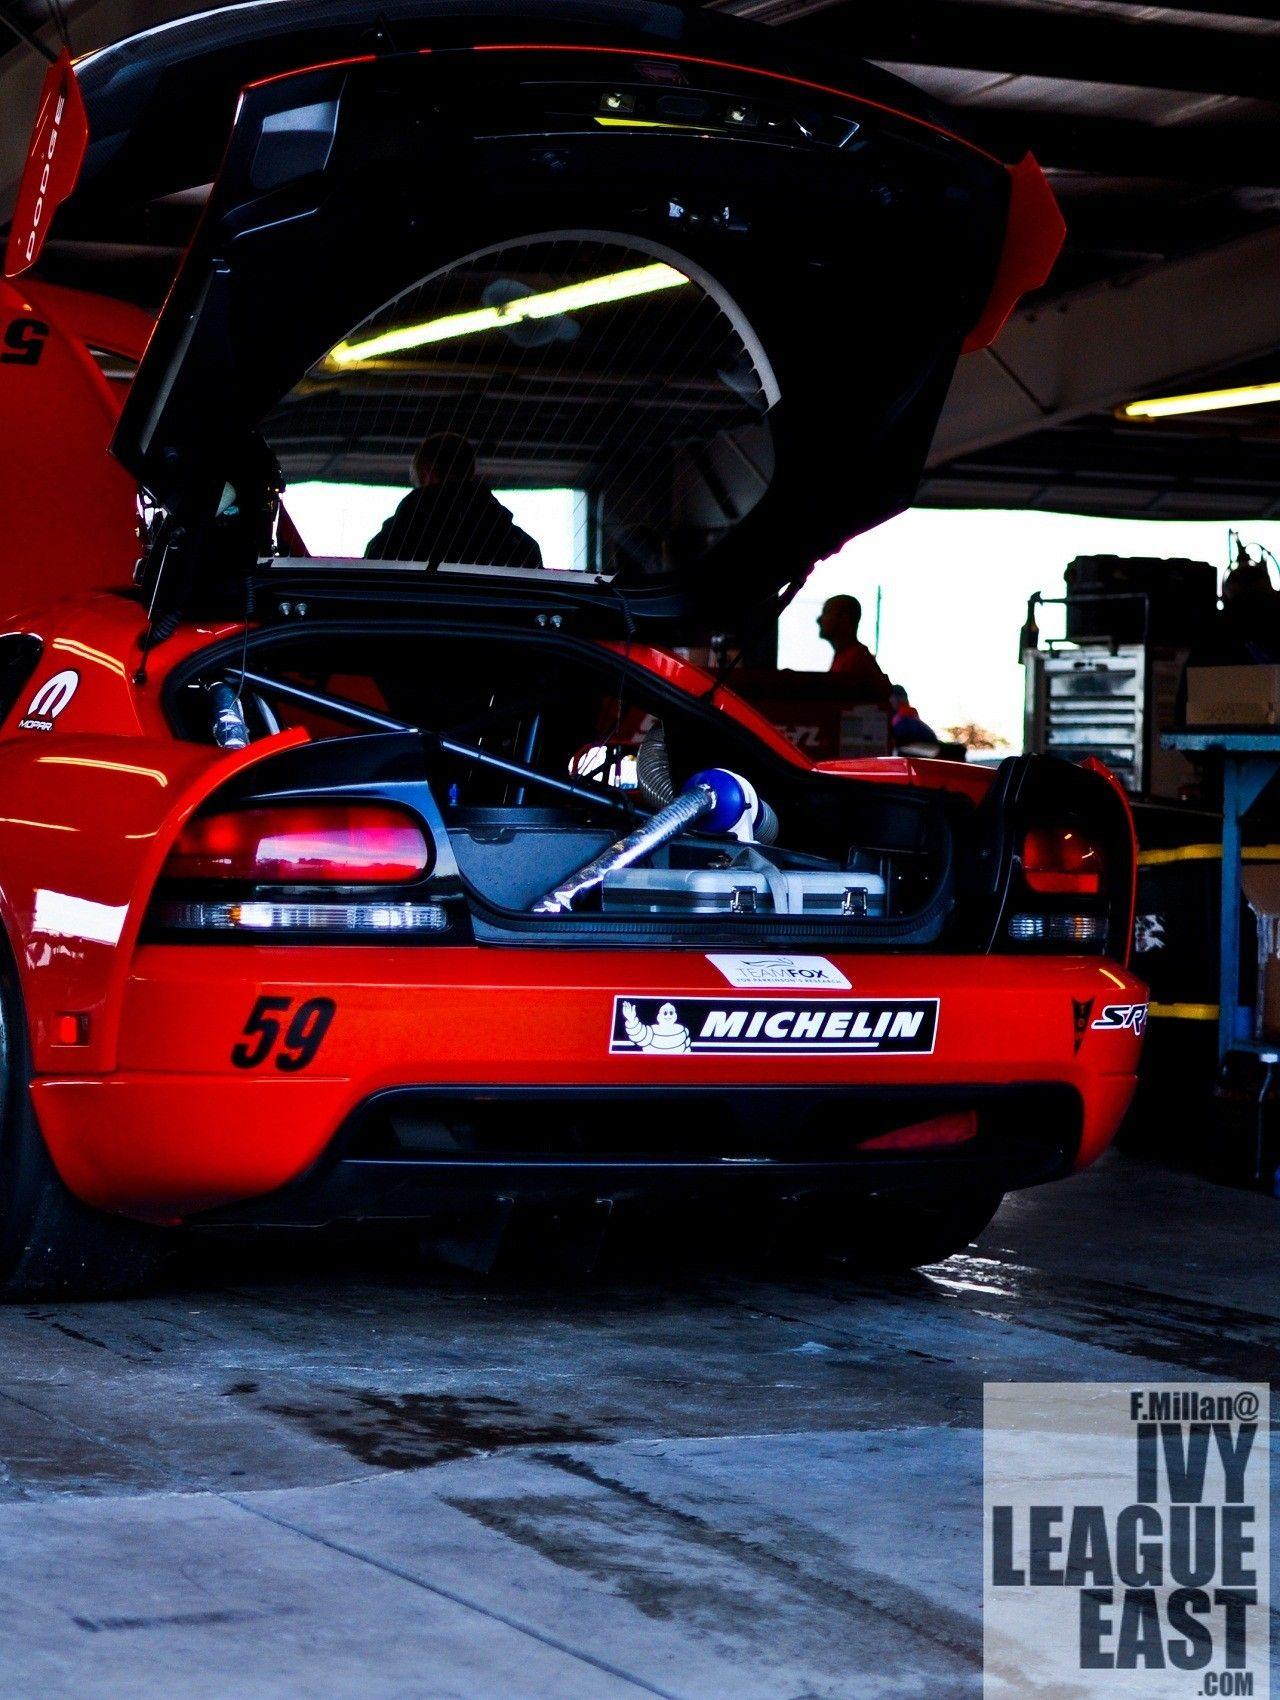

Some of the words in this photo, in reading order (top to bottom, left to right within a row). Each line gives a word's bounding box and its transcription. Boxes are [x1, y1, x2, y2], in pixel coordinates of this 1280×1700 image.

[26, 95, 65, 261] DODGE
[19, 719, 53, 731] MOPAR
[231, 996, 337, 1072] 59
[700, 1011, 925, 1038] MICHELIN
